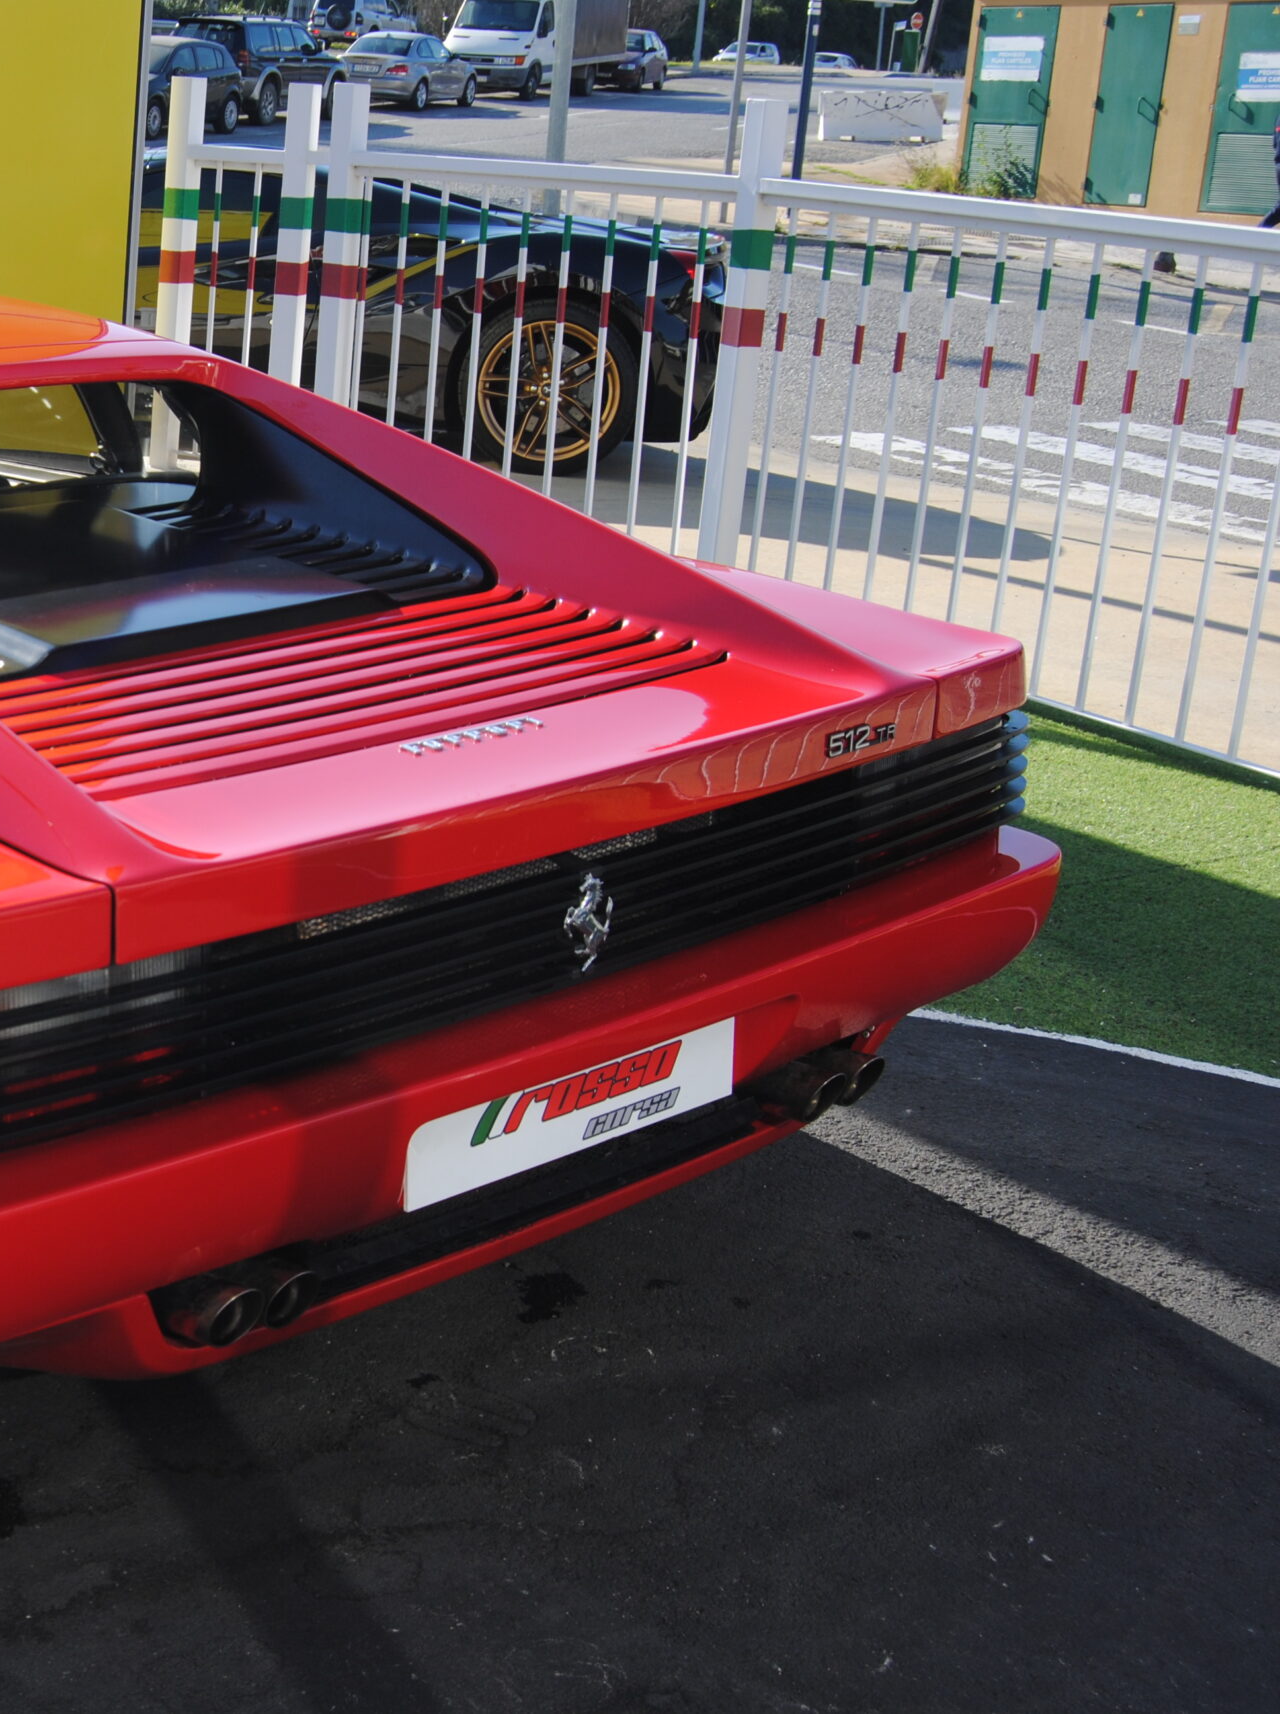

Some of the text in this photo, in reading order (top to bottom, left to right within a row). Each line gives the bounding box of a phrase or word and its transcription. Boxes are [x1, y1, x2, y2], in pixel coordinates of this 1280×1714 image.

[827, 723, 897, 758] 512 TR
[504, 1039, 683, 1134] rosso
[582, 1086, 681, 1141] corsa
